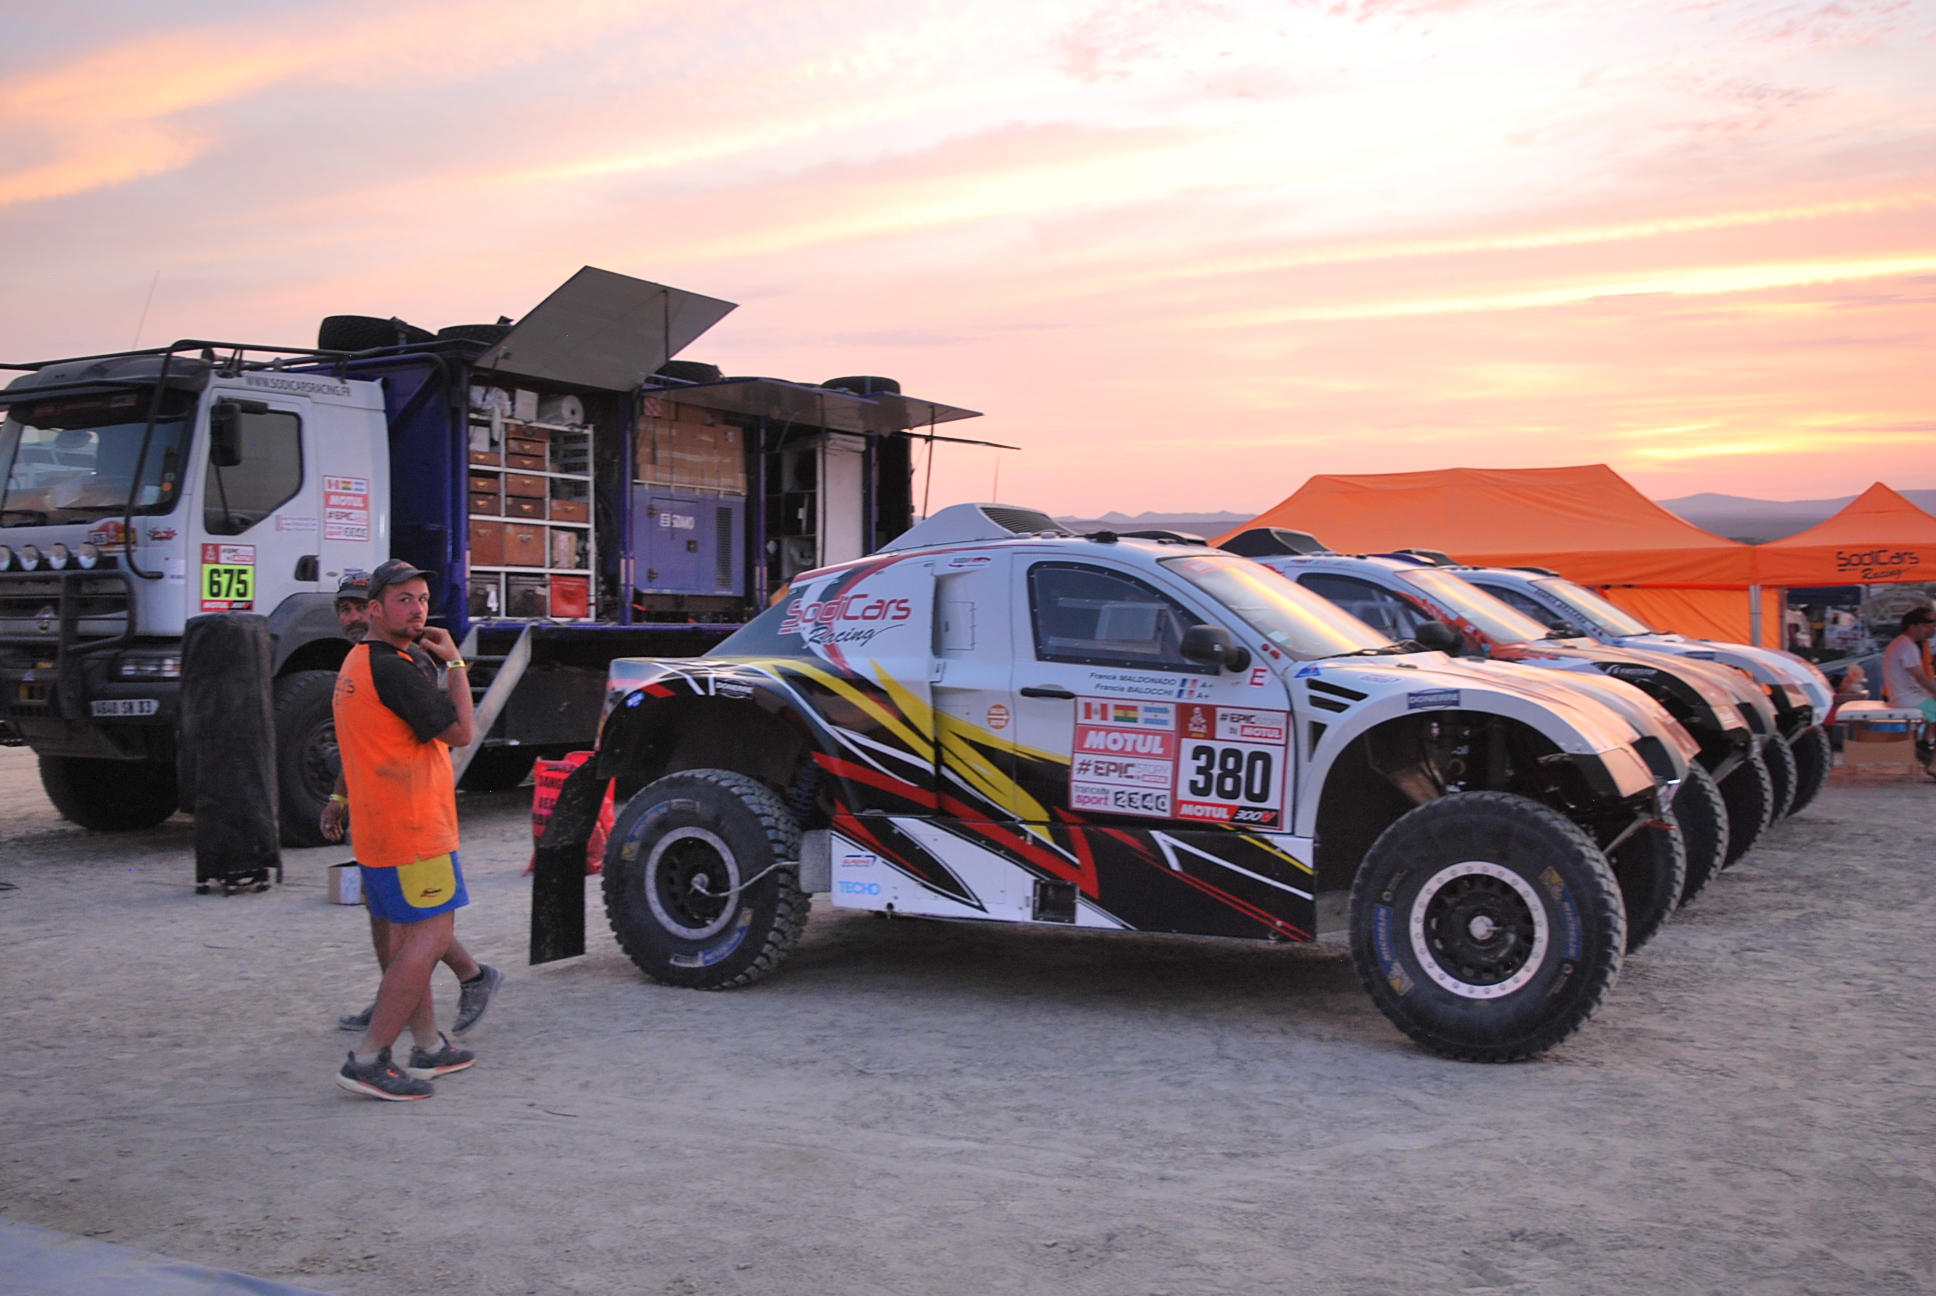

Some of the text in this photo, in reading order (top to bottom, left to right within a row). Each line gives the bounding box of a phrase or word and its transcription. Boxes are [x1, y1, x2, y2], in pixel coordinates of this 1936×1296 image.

[209, 568, 248, 598] 675
[781, 593, 912, 627] SodiCars
[808, 624, 892, 647] Racing
[1089, 672, 1118, 682] Franck
[1120, 674, 1176, 686] MALDONADO
[1249, 668, 1268, 687] E
[1095, 683, 1125, 693] Francis
[1127, 685, 1174, 696] BALOCCHI
[1083, 730, 1165, 755] MOTUL
[1242, 727, 1281, 738] MOTUL
[1189, 744, 1272, 803] 380
[1075, 795, 1109, 806] sport
[1180, 803, 1278, 823] MOTUL 300V
